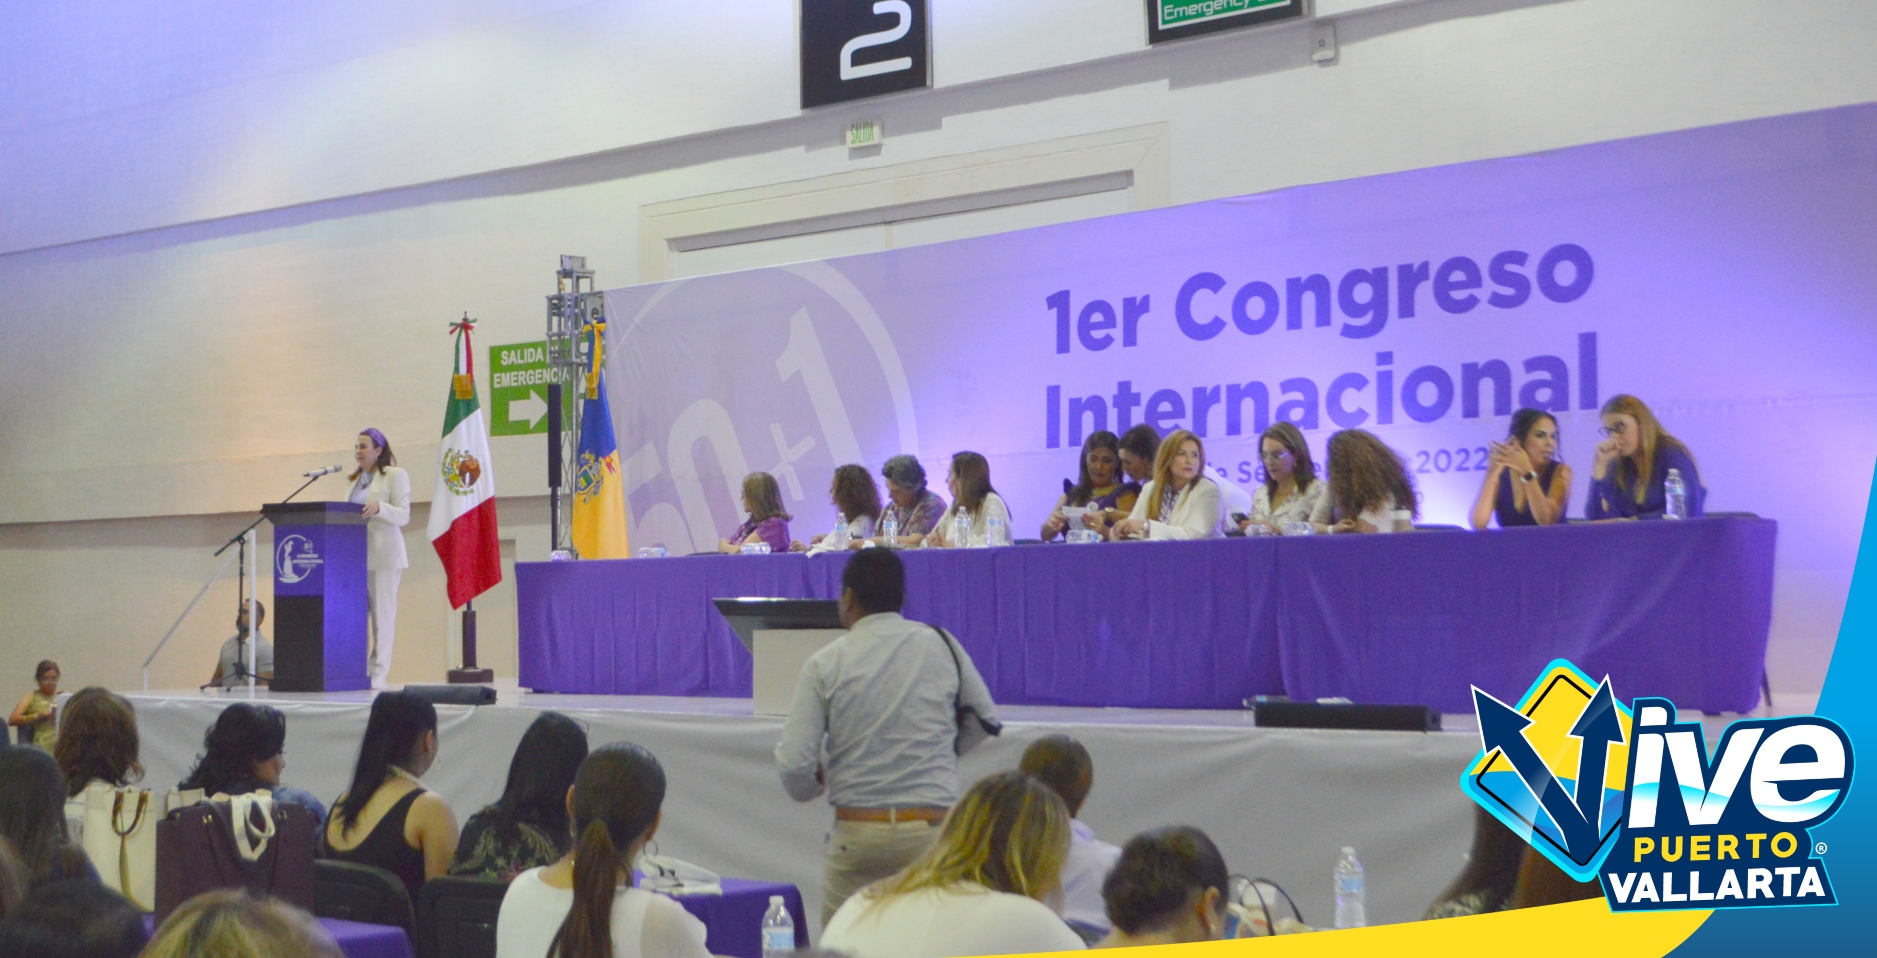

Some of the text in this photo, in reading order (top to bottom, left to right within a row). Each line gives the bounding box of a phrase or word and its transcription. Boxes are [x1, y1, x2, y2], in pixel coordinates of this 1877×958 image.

[840, 0, 912, 80] 2
[850, 121, 874, 144] SALIDA
[1046, 243, 1594, 354] 1er Congreso
[501, 347, 544, 366] SALIDA
[1046, 331, 1598, 449] Internacional
[1416, 446, 1489, 474] 2022
